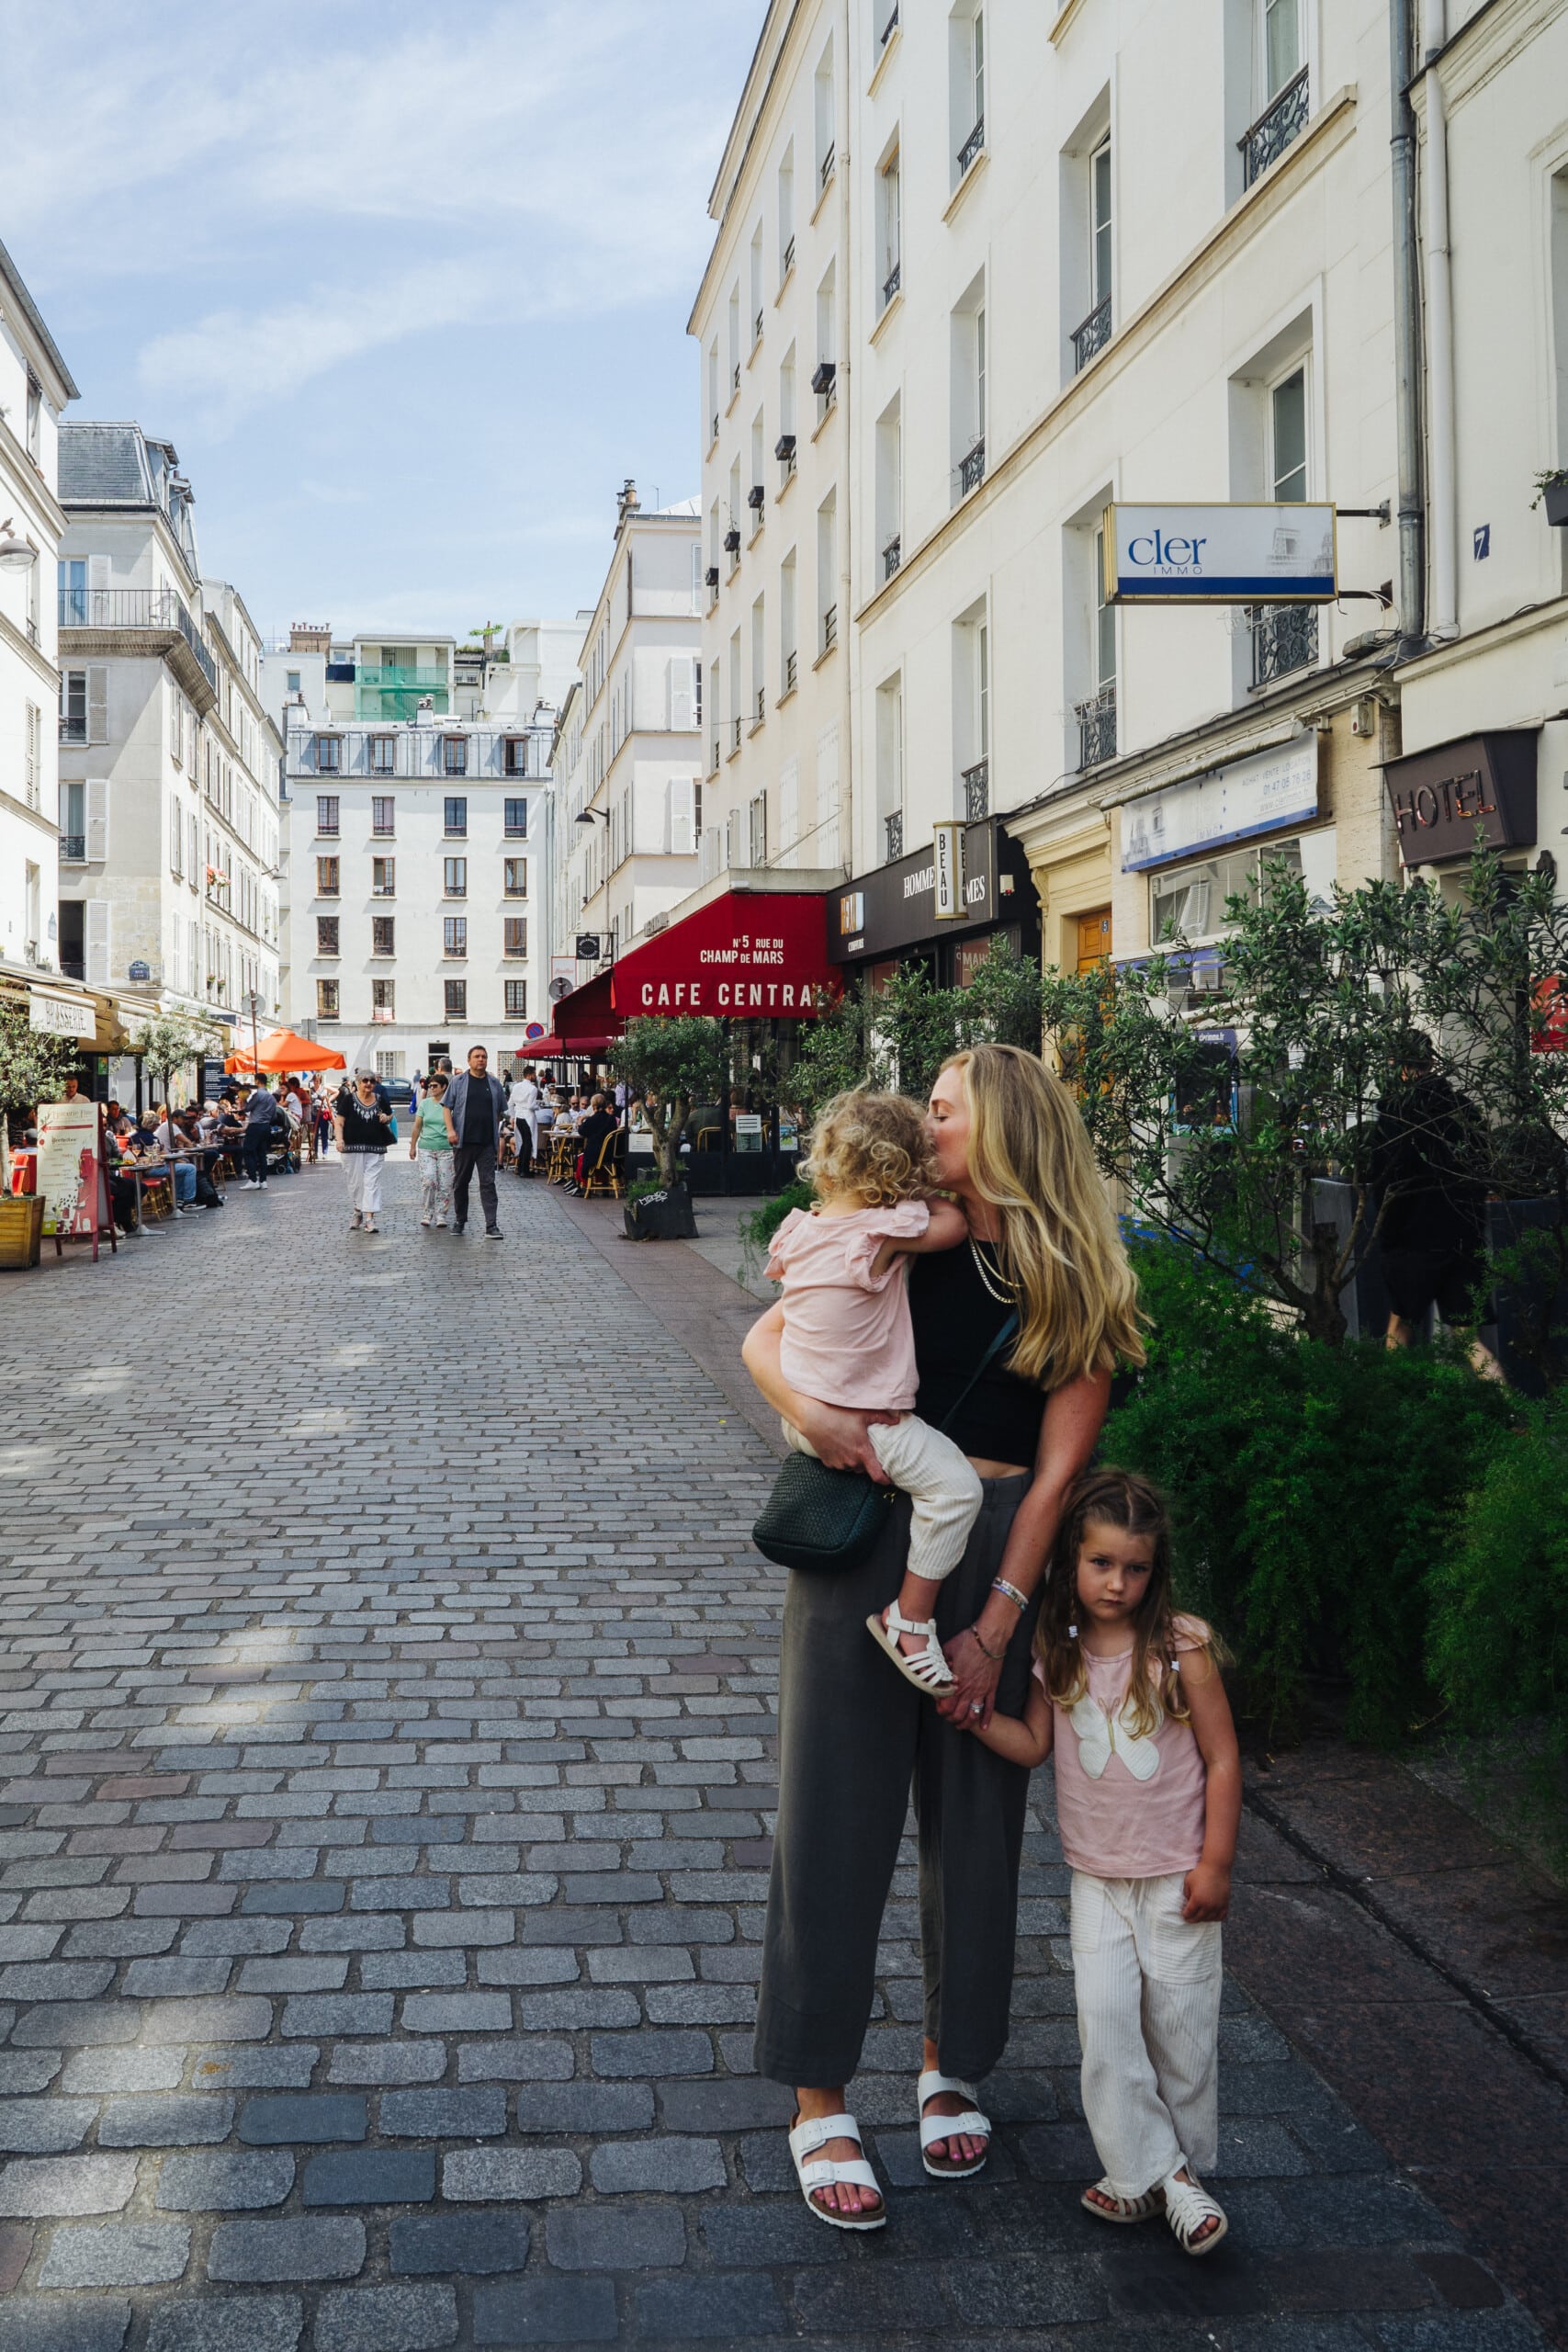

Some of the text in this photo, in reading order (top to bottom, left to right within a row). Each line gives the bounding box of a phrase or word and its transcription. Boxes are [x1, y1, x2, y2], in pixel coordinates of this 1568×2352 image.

[1128, 529, 1207, 565] cler
[1475, 530, 1485, 561] 7
[1154, 566, 1202, 575] IMMO
[1394, 769, 1496, 834] HOTEL
[939, 833, 947, 906] BEAU
[755, 938, 771, 948] RUE
[773, 939, 784, 948] DU
[700, 950, 784, 964] CHAMP DE MARS
[642, 983, 701, 1006] CAFE
